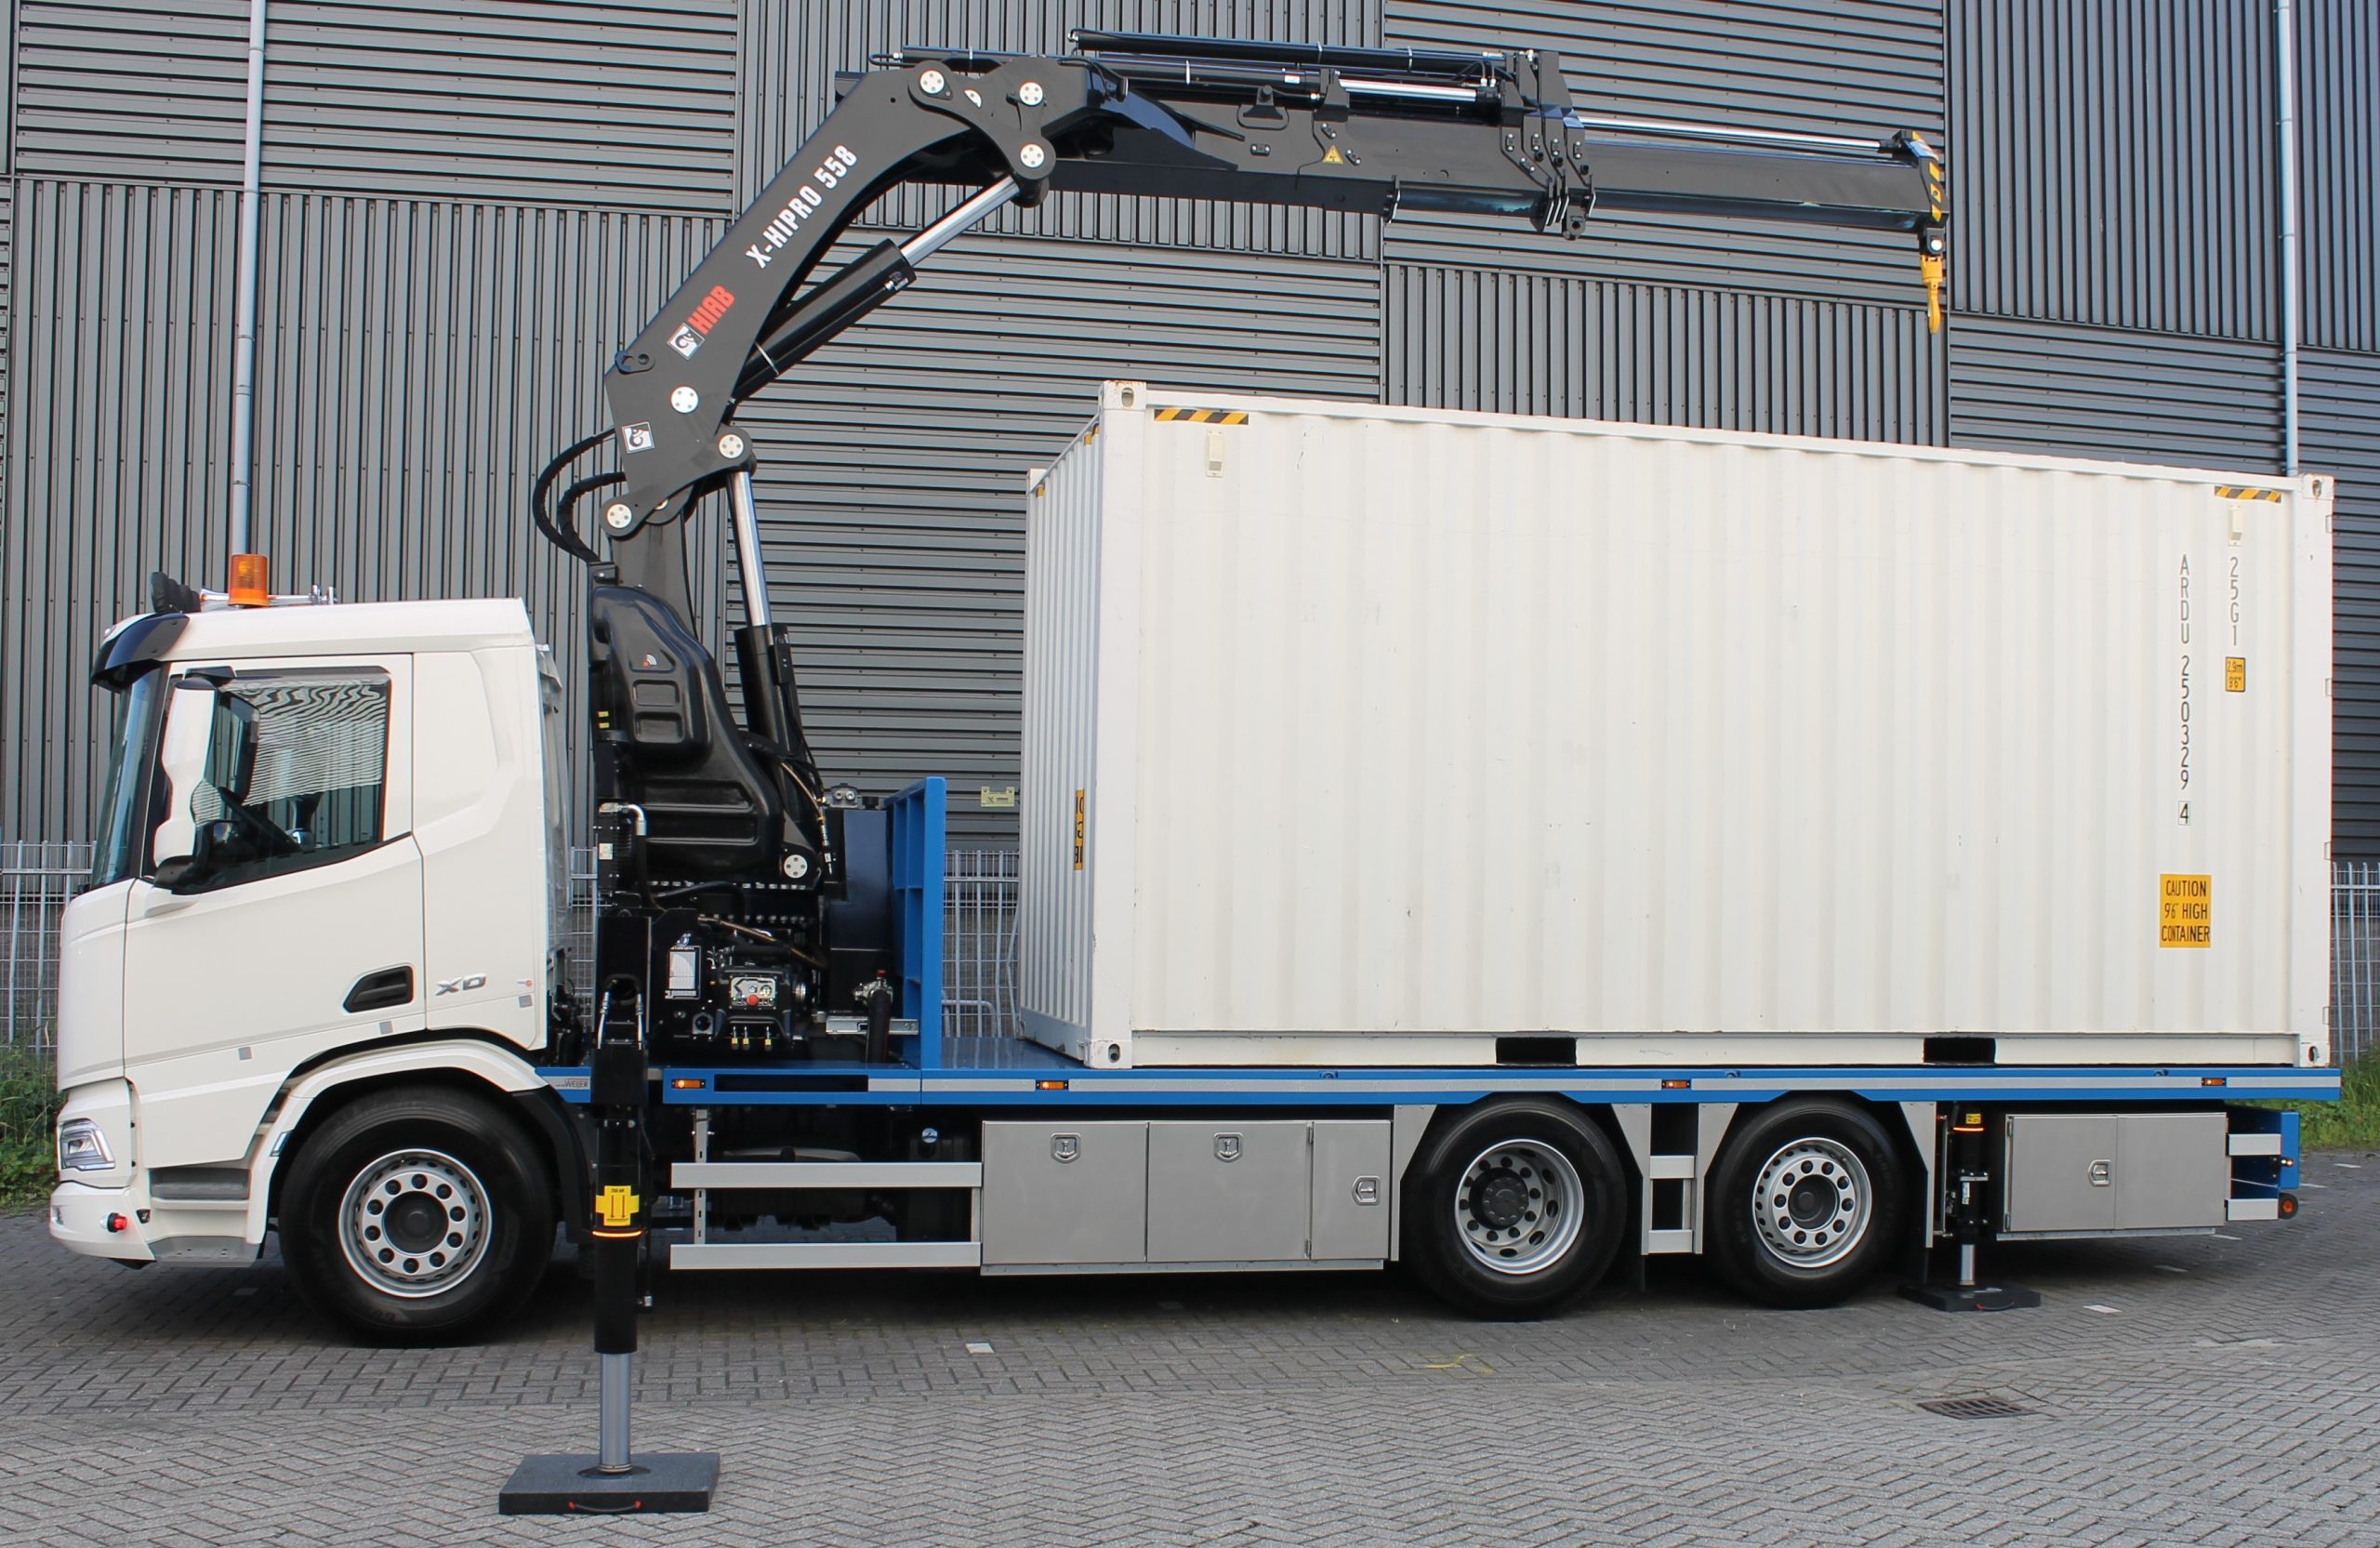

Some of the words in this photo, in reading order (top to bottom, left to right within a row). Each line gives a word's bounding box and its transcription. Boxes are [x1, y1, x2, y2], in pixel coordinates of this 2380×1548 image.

[746, 185, 823, 270] X-HIPRO
[813, 144, 858, 190] 558
[686, 284, 735, 336] HIAB
[2179, 553, 2190, 644] ARDU
[2229, 556, 2240, 647] 25G1
[2180, 655, 2190, 790] 250329
[2179, 802, 2189, 825] 4
[2165, 880, 2207, 897] CAUTION
[2182, 903, 2208, 920] HIGH
[2161, 925, 2211, 943] CONTAINER
